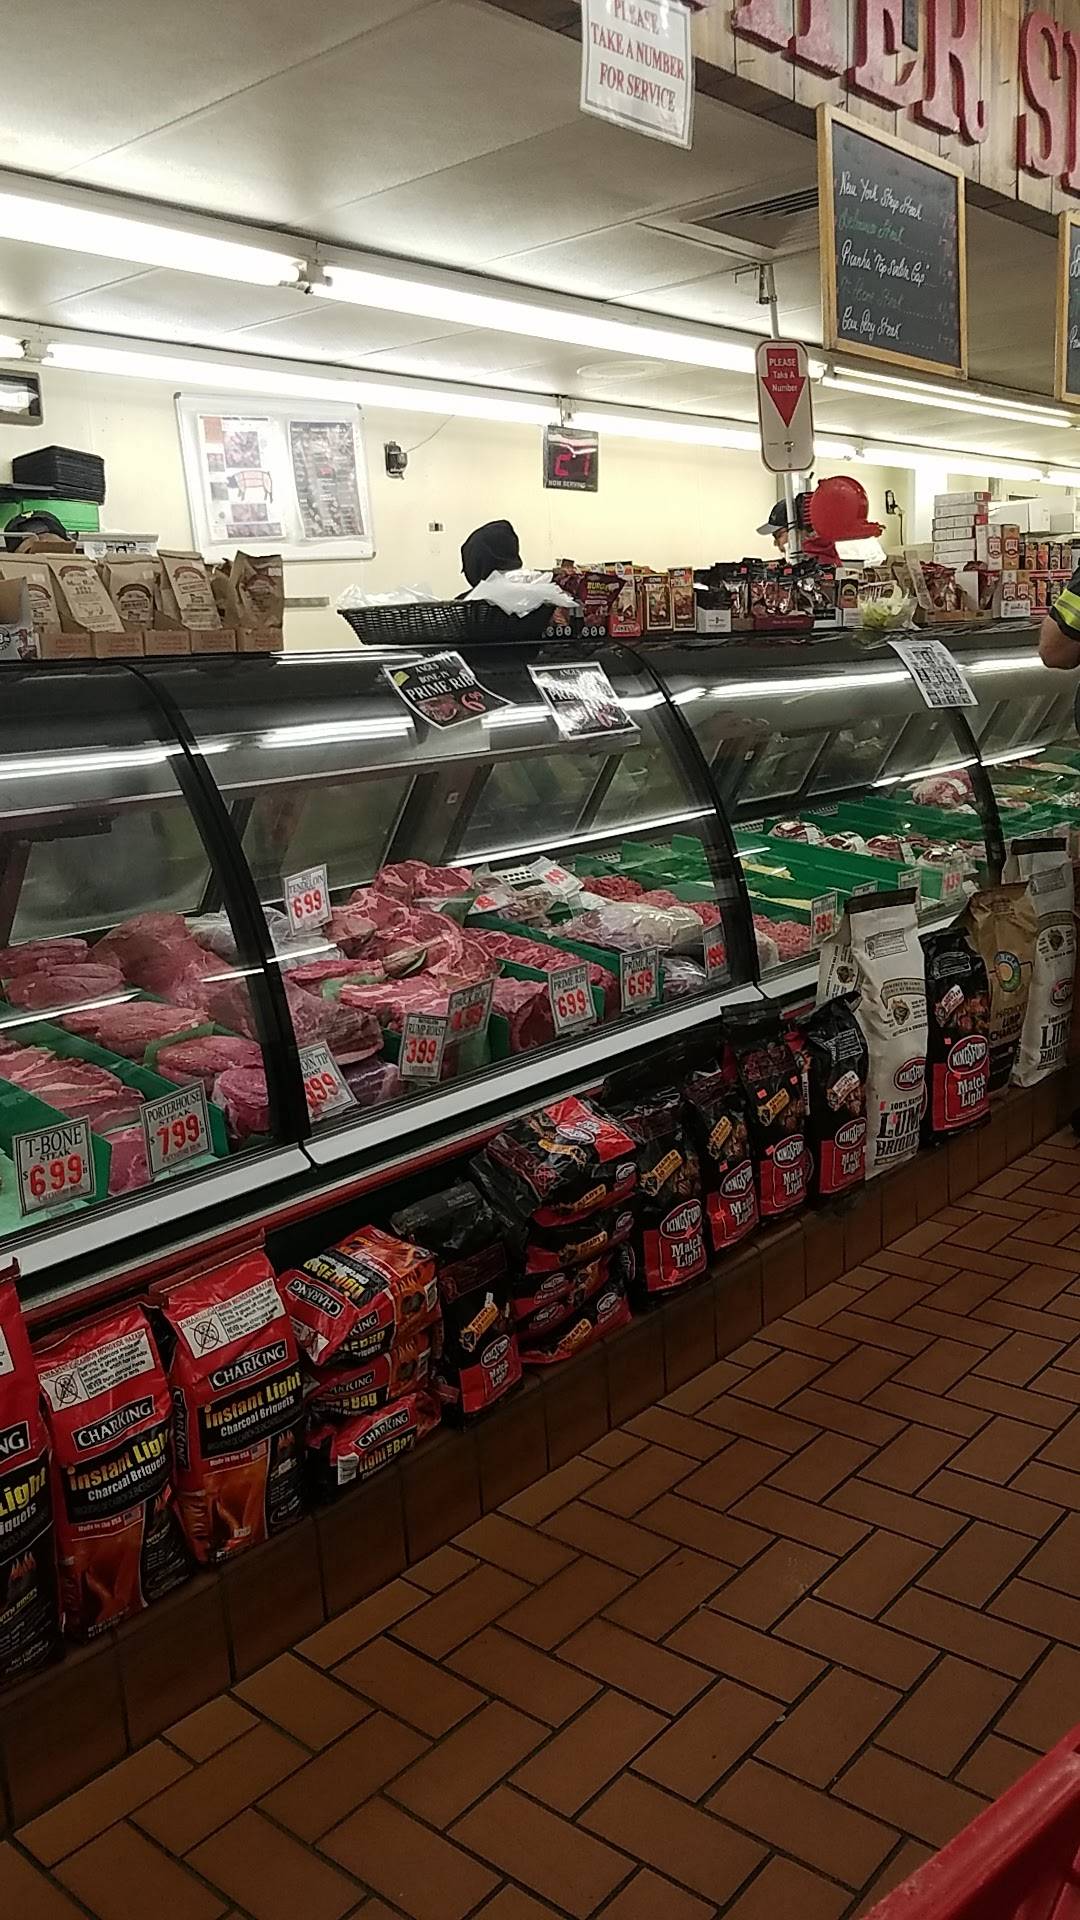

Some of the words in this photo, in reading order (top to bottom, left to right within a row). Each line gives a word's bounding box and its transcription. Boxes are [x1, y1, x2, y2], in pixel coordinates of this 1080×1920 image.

[591, 22, 623, 56] TAKE
[626, 38, 634, 60] A
[636, 41, 685, 81] NUMBER
[600, 62, 625, 93] FOR
[626, 73, 676, 112] SERVICE
[860, 178, 879, 203] York
[769, 358, 796, 367] PLEASE
[773, 371, 788, 379] Take
[790, 371, 796, 379] A
[772, 384, 797, 392] Number
[405, 680, 453, 701] PRIME
[448, 671, 475, 690] RIB
[294, 890, 322, 918] 699
[628, 972, 653, 996] 699
[558, 988, 587, 1018] 699
[406, 1039, 437, 1064] 399
[952, 1043, 986, 1067] KINGSFORD
[957, 1073, 986, 1096] Match
[960, 1086, 985, 1108] Light
[148, 1090, 201, 1122] PORTERHOUSE
[159, 1107, 191, 1127] STEAK
[25, 1126, 83, 1158] T-BONE
[157, 1114, 200, 1156] 799
[40, 1147, 71, 1162] STEAK
[30, 1154, 83, 1196] 699
[213, 1345, 285, 1387] CHARKING
[204, 1391, 264, 1429] instant
[265, 1371, 301, 1403] Light
[77, 1402, 152, 1447] CHARKING
[220, 1411, 260, 1437] Charcoal
[259, 1395, 295, 1418] Briquets
[358, 1412, 409, 1447] CHARKING
[66, 1452, 134, 1491] instant
[87, 1474, 131, 1501] Charcoal
